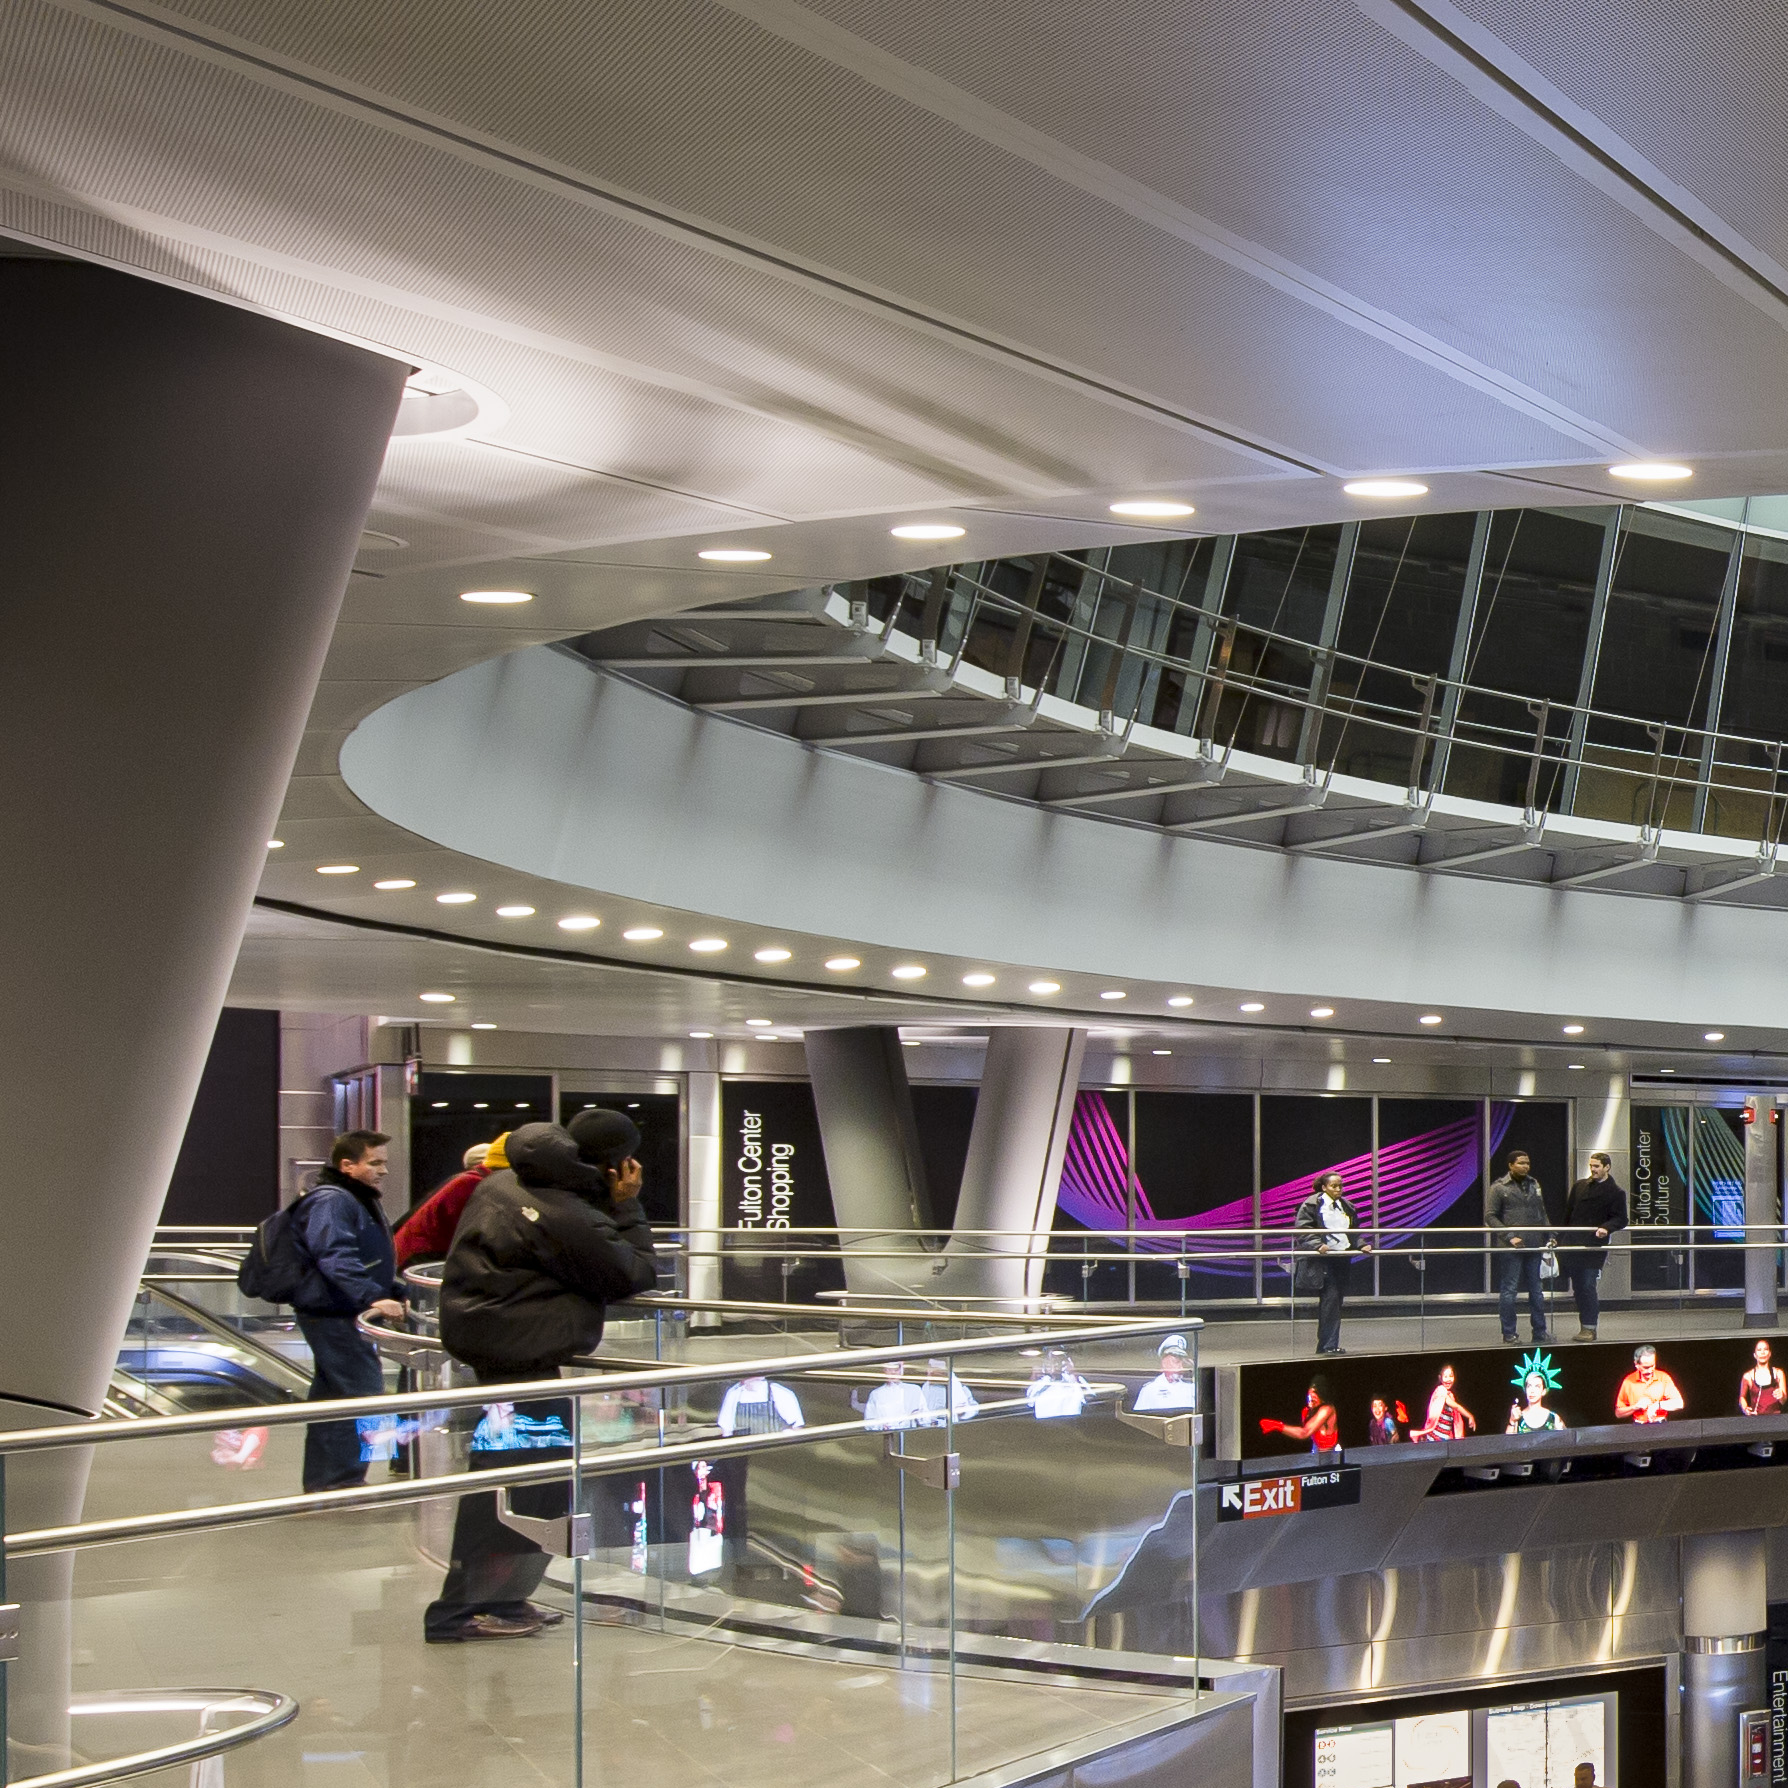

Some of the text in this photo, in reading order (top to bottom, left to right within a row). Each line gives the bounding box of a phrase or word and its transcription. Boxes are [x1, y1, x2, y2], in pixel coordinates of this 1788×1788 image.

[738, 1109, 762, 1173] Center
[1636, 1129, 1651, 1180] Center
[766, 1143, 795, 1228] Shopping
[1654, 1175, 1670, 1225] Culture
[1244, 1472, 1340, 1513] Exit Fulton St
[1772, 1670, 1788, 1784] Entertainment
